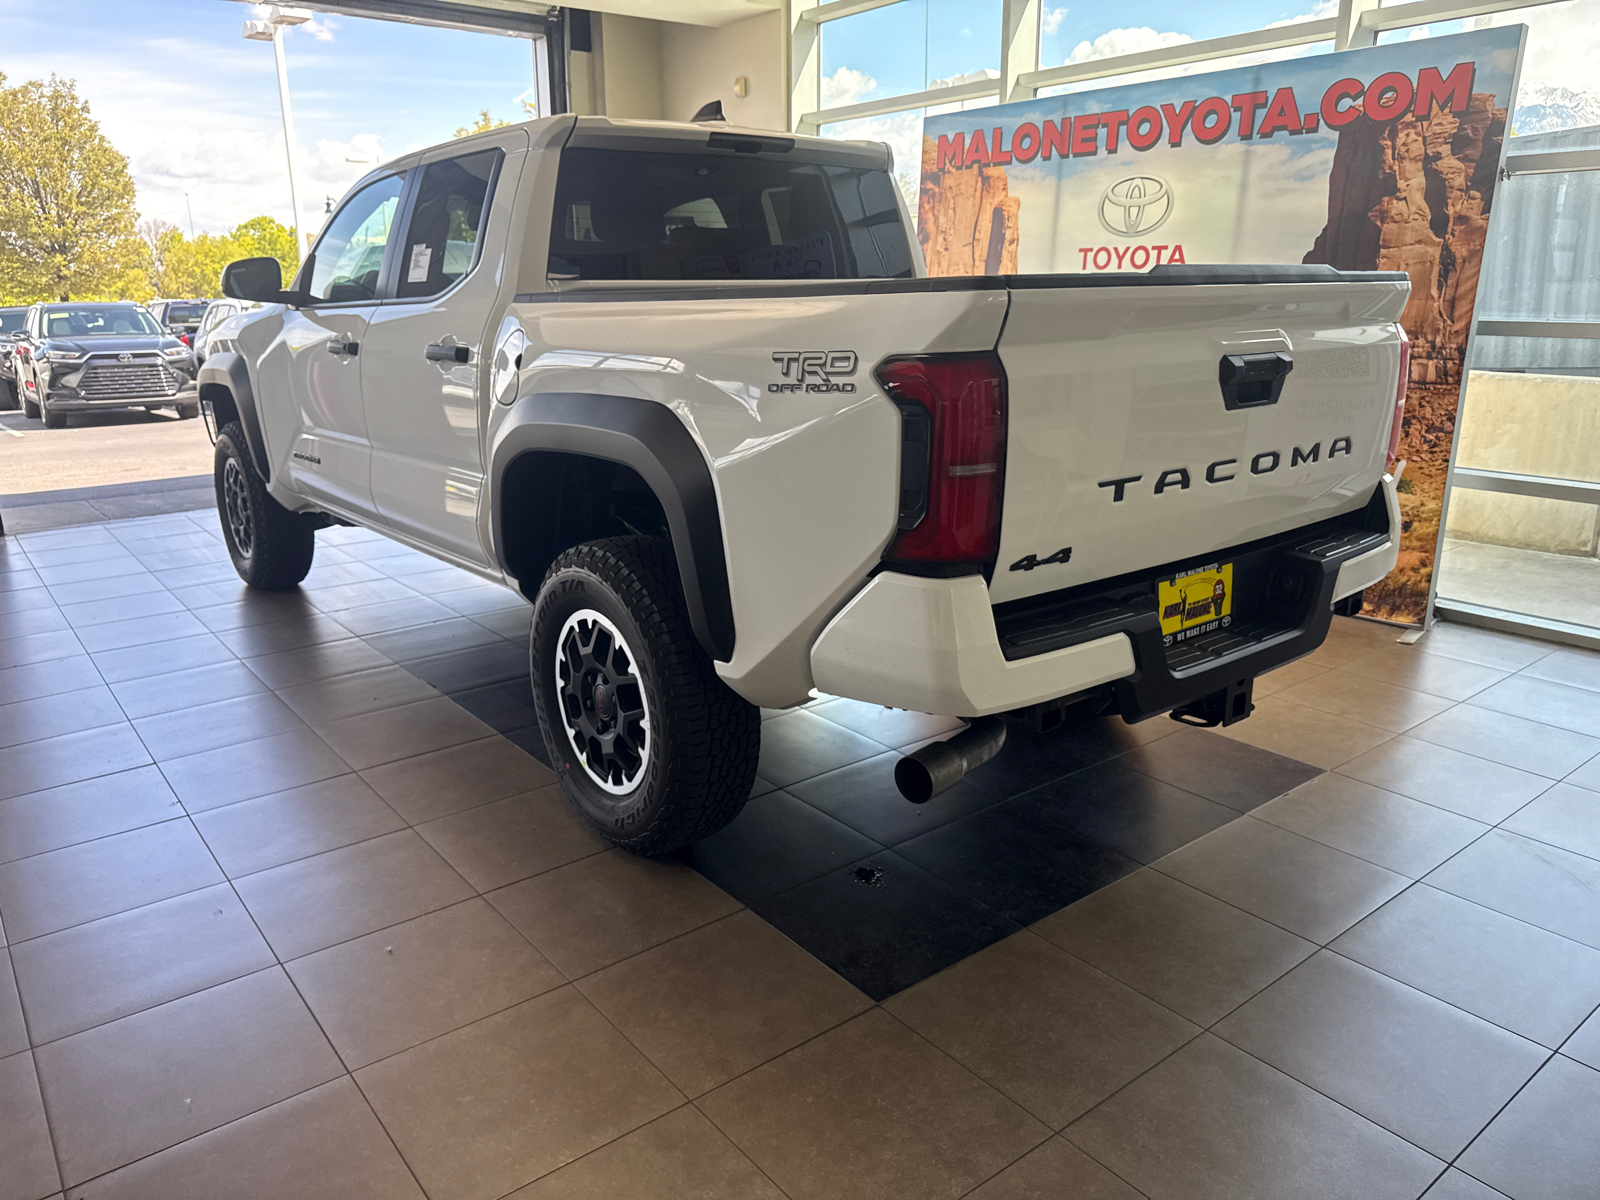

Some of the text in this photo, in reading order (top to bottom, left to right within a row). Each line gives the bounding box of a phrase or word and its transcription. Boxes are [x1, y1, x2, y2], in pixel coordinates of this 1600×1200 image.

[937, 61, 1476, 170] MALONETOYOTA.COM
[1078, 244, 1186, 271] TOYOTA
[772, 350, 859, 384] TRD
[767, 382, 857, 394] OFF ROAD
[1097, 435, 1352, 503] TACOMA
[1177, 621, 1219, 641] WE MAKE IT EASY
